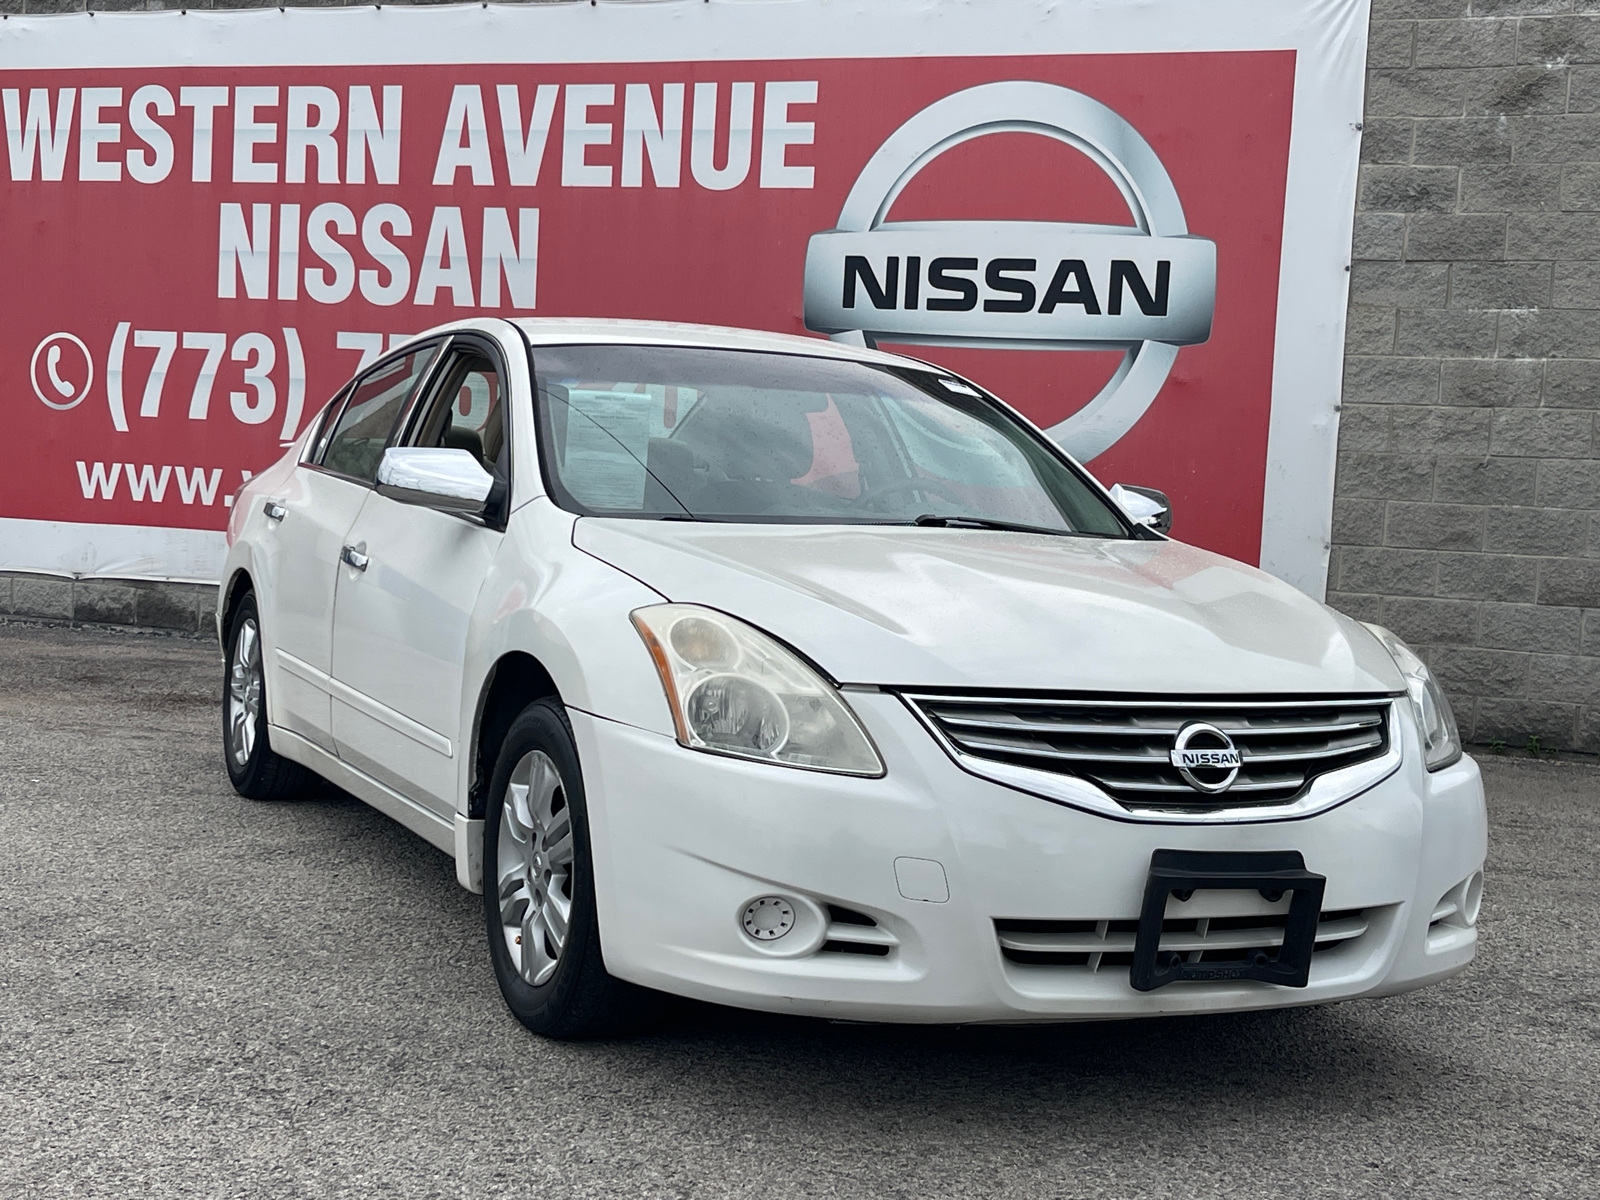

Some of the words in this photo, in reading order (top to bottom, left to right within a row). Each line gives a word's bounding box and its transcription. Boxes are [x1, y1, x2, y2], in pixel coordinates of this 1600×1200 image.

[2, 84, 403, 184] WESTERN
[432, 80, 819, 191] AVENUE
[217, 202, 541, 309] NISSAN
[842, 255, 1171, 316] NISSAN
[107, 321, 306, 441] (773)
[1182, 753, 1239, 764] NISSAN
